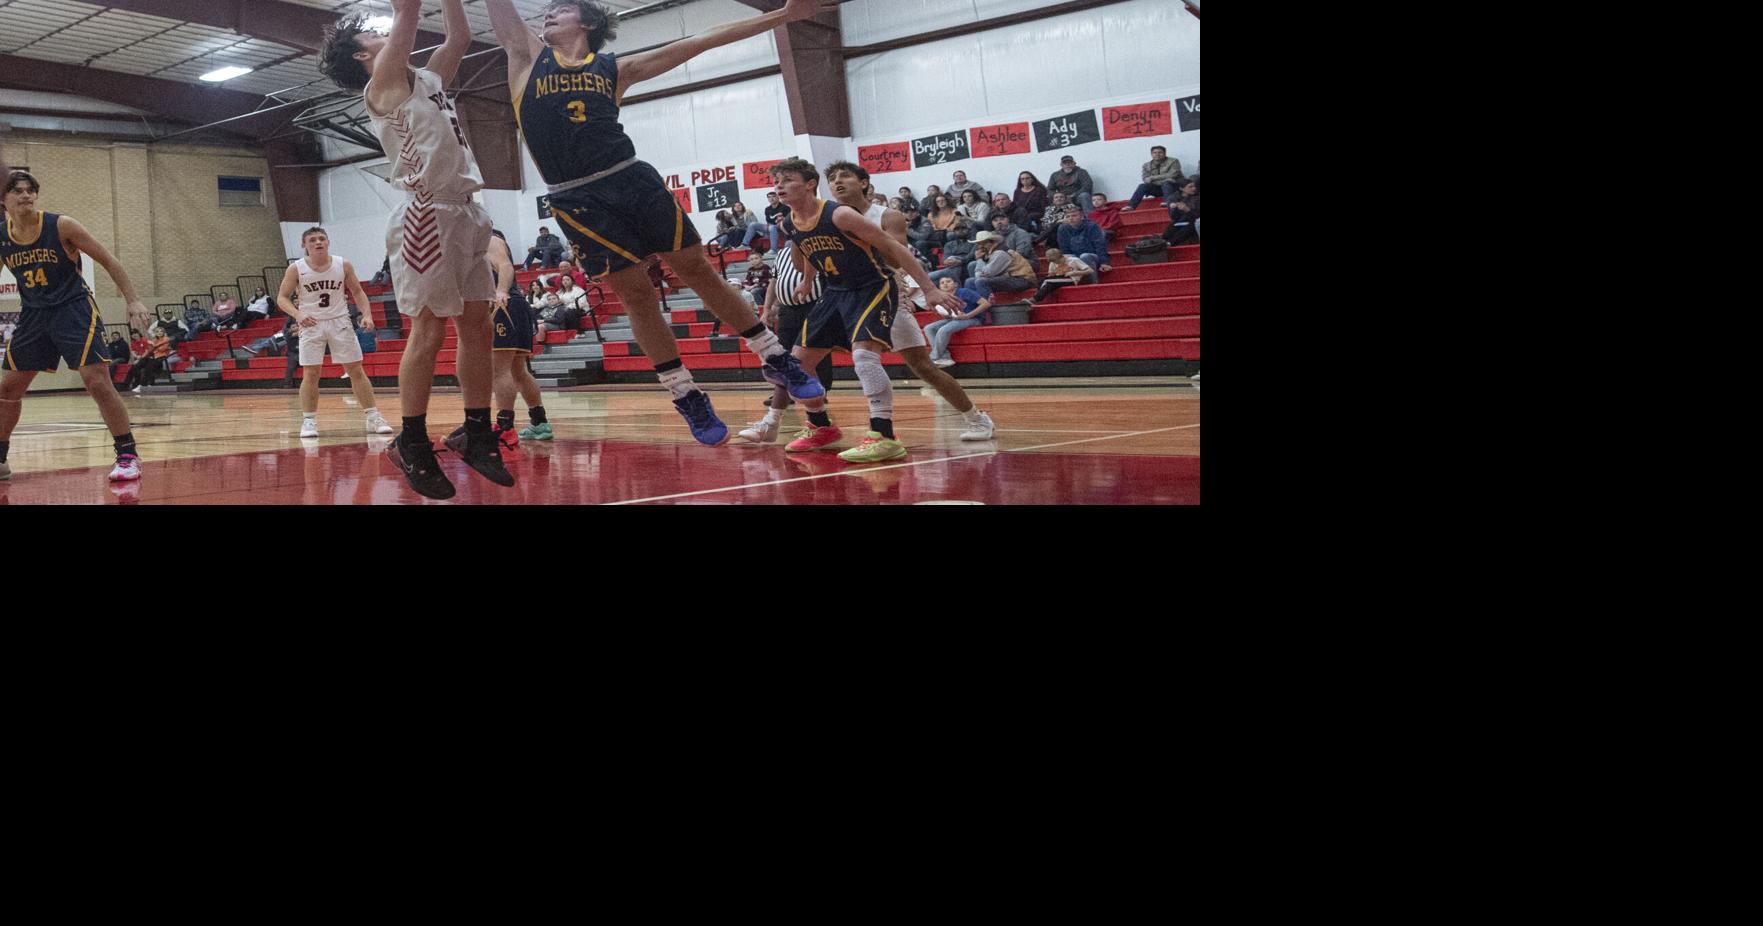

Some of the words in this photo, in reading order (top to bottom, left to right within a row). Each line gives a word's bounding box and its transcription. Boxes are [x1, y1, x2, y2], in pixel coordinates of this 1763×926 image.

[535, 72, 613, 99] MUSHERS
[566, 100, 587, 123] 3
[1109, 109, 1161, 125] Denym
[977, 125, 1026, 145] Ashlee
[1049, 118, 1078, 139] Ady
[914, 133, 965, 156] Bryleigh
[859, 149, 908, 163] Courtney
[691, 165, 735, 186] PRIDE
[707, 186, 719, 198] Jr
[5, 248, 59, 269] MUSHERS
[23, 267, 49, 289] 34
[303, 280, 343, 293] DEVILS
[318, 293, 331, 308] 3
